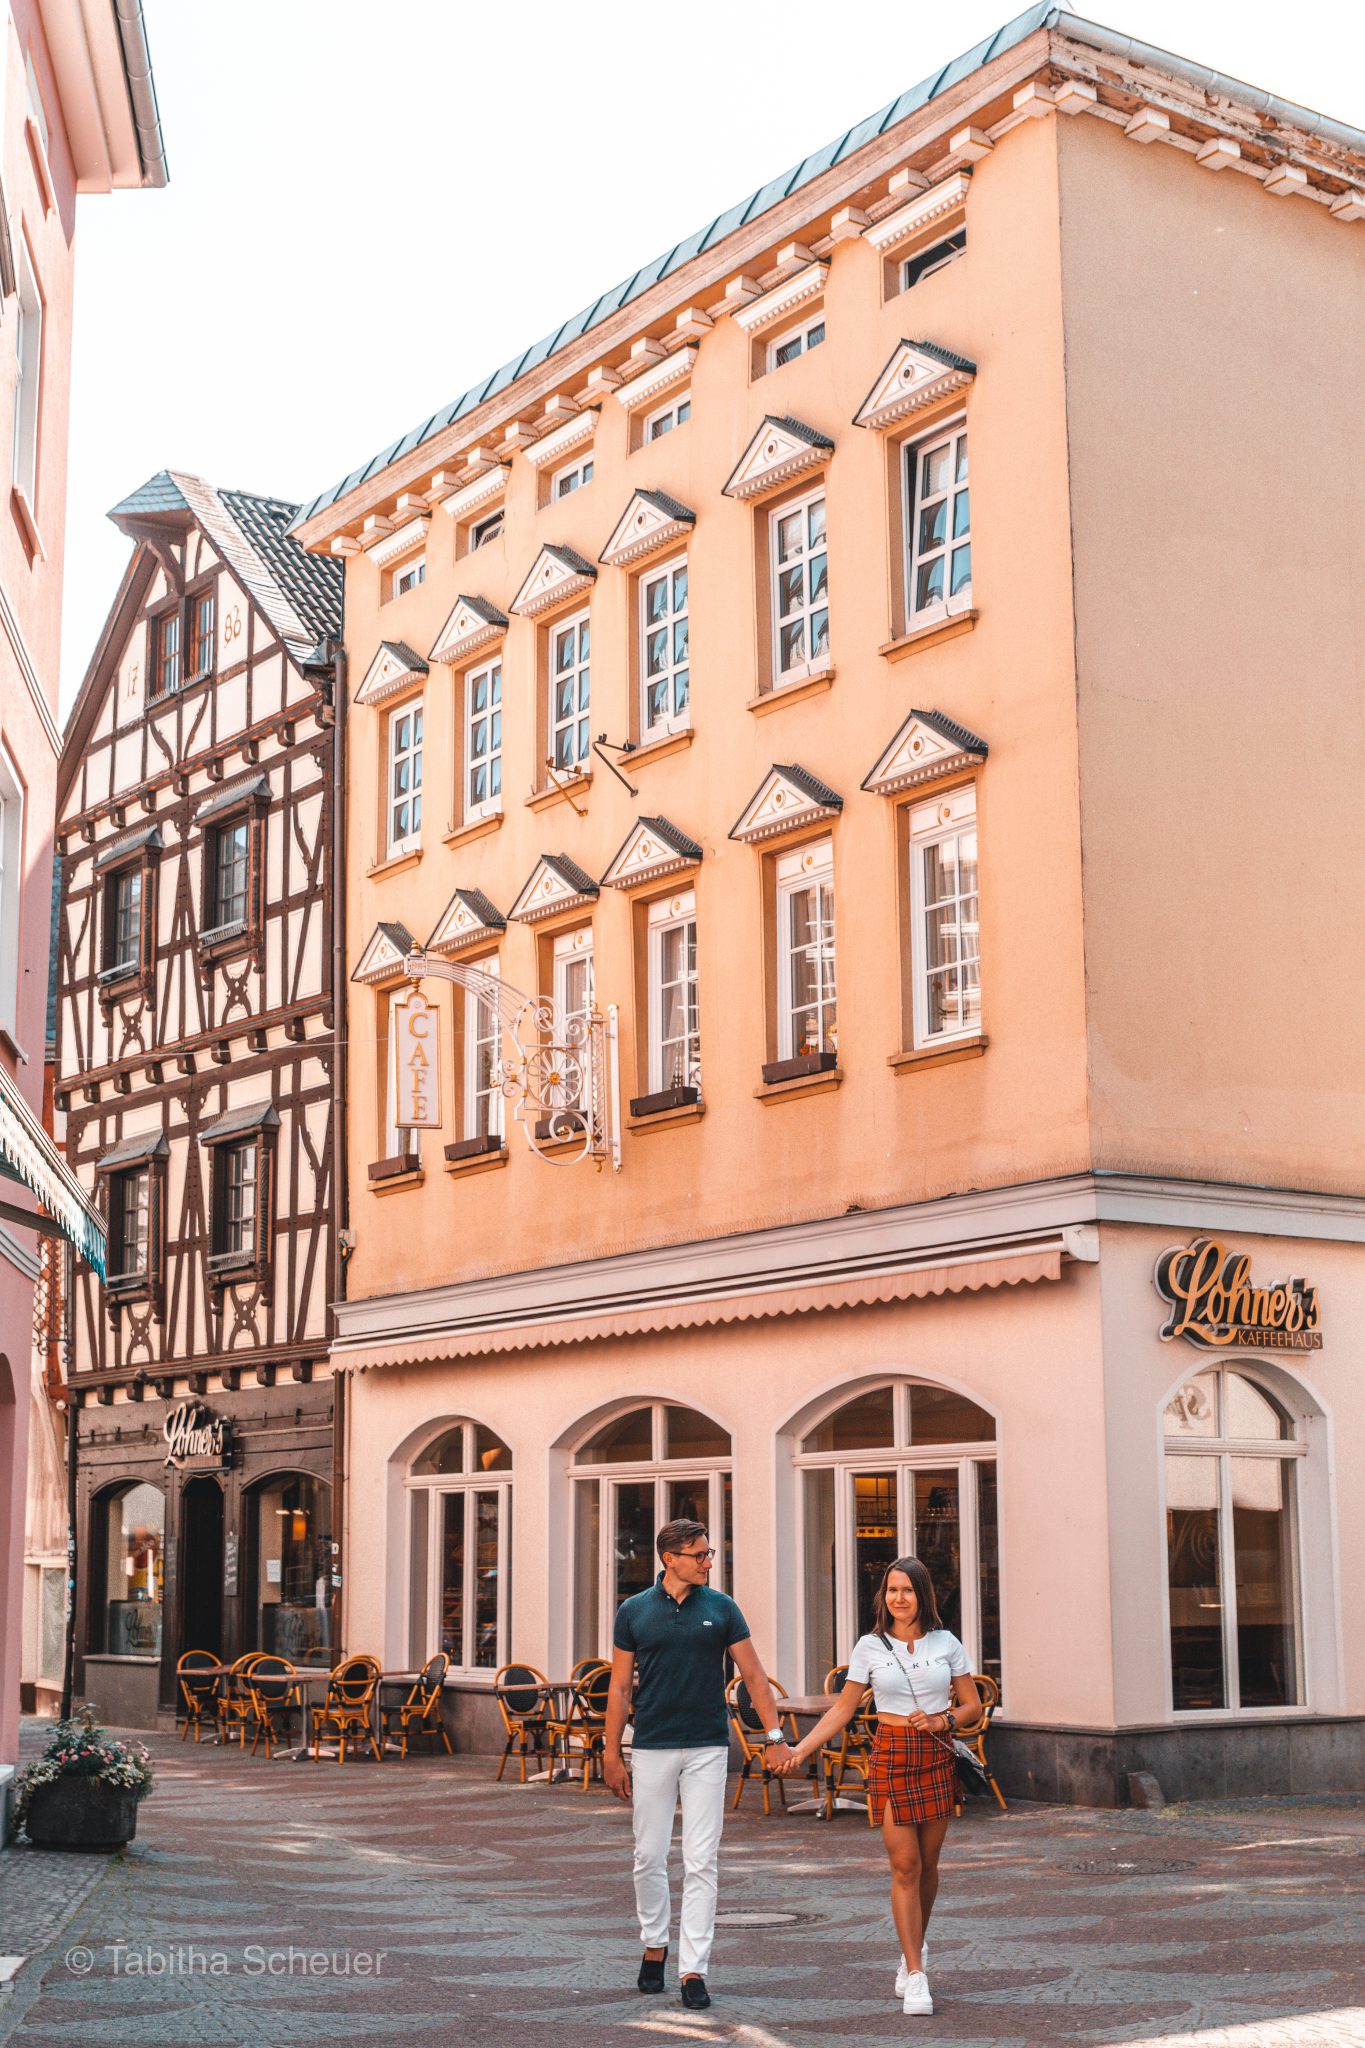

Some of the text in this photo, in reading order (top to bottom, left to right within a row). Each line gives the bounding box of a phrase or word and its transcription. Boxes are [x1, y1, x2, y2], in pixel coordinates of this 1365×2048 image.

[224, 605, 241, 644] 86
[408, 1012, 429, 1120] CAFE
[1168, 1239, 1321, 1345] Lohner's
[1238, 1330, 1321, 1347] KAFFEEHAUS
[163, 1402, 223, 1469] Lohner's
